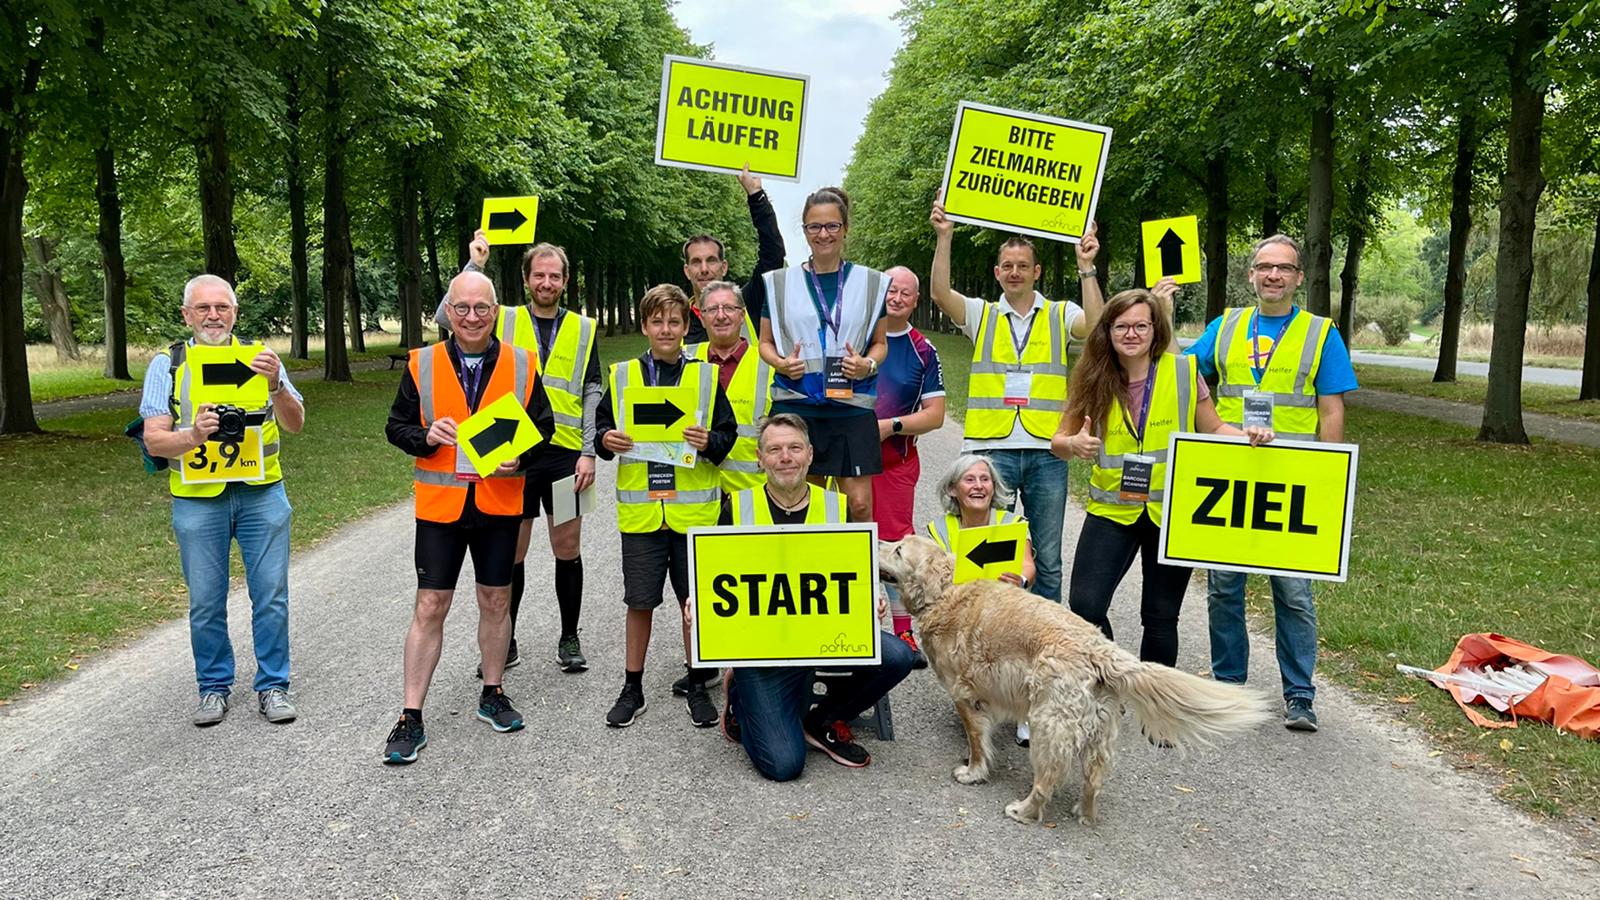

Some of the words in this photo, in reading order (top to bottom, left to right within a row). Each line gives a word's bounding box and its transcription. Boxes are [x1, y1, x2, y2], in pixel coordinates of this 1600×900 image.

[677, 86, 794, 122] ACHTUNG
[687, 115, 780, 150] LÄUFER
[1008, 125, 1056, 151] BITTE
[969, 145, 1082, 184] ZIELMARKEN
[956, 170, 1085, 211] ZURÜCKGEBEN
[1041, 212, 1081, 233] parkrun
[1150, 419, 1173, 428] Helfer
[188, 441, 240, 473] 3,9
[240, 458, 257, 468] km
[1191, 477, 1318, 535] ZIEL
[712, 572, 857, 618] START
[819, 632, 868, 655] parkrun
